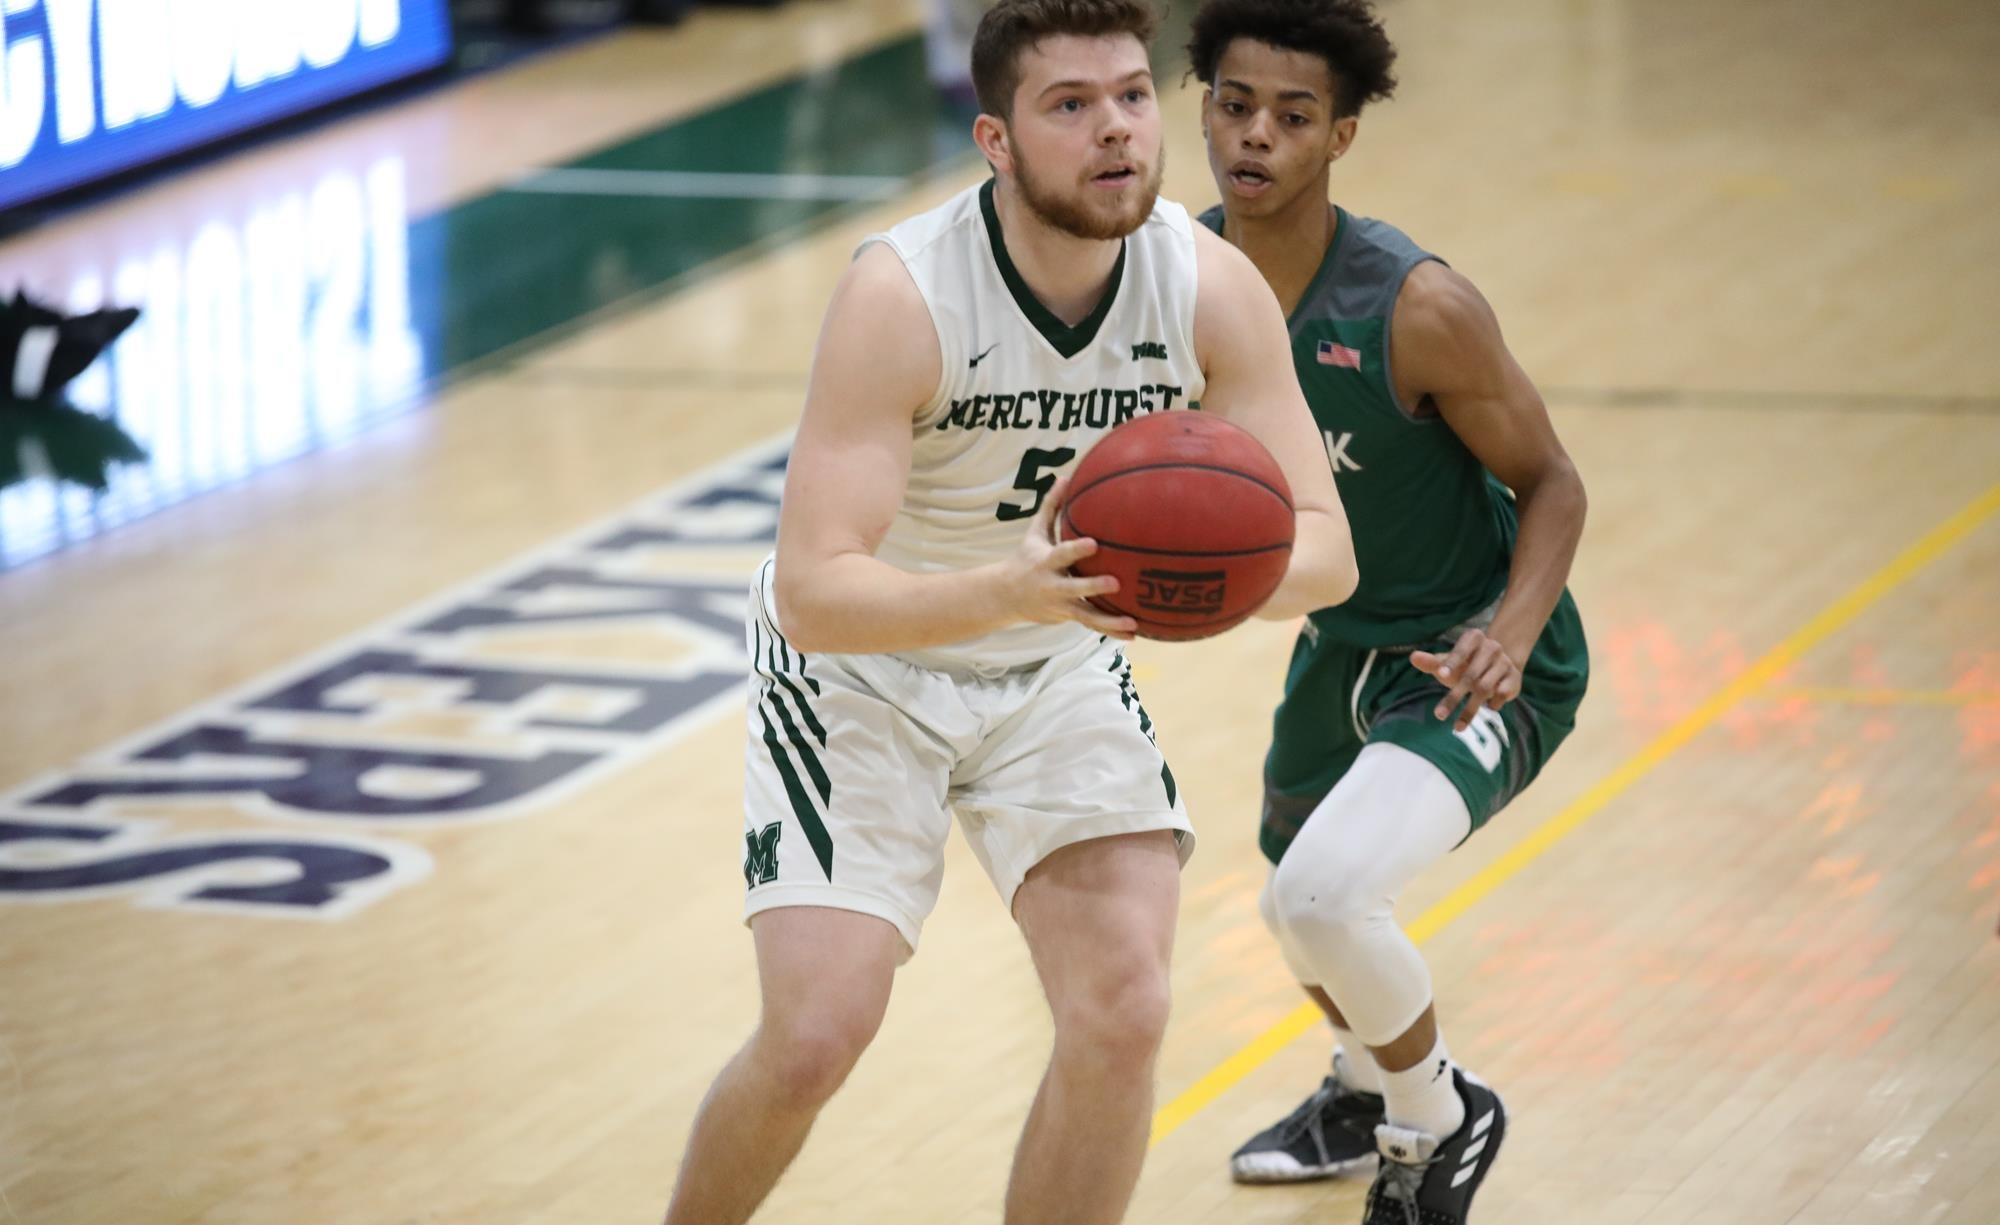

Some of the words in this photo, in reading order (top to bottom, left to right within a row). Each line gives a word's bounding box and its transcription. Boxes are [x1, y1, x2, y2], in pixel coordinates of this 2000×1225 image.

[936, 384, 1182, 431] MERCYHURST
[996, 447, 1076, 521] 5
[1136, 579, 1226, 607] PSAC
[744, 821, 782, 890] M
